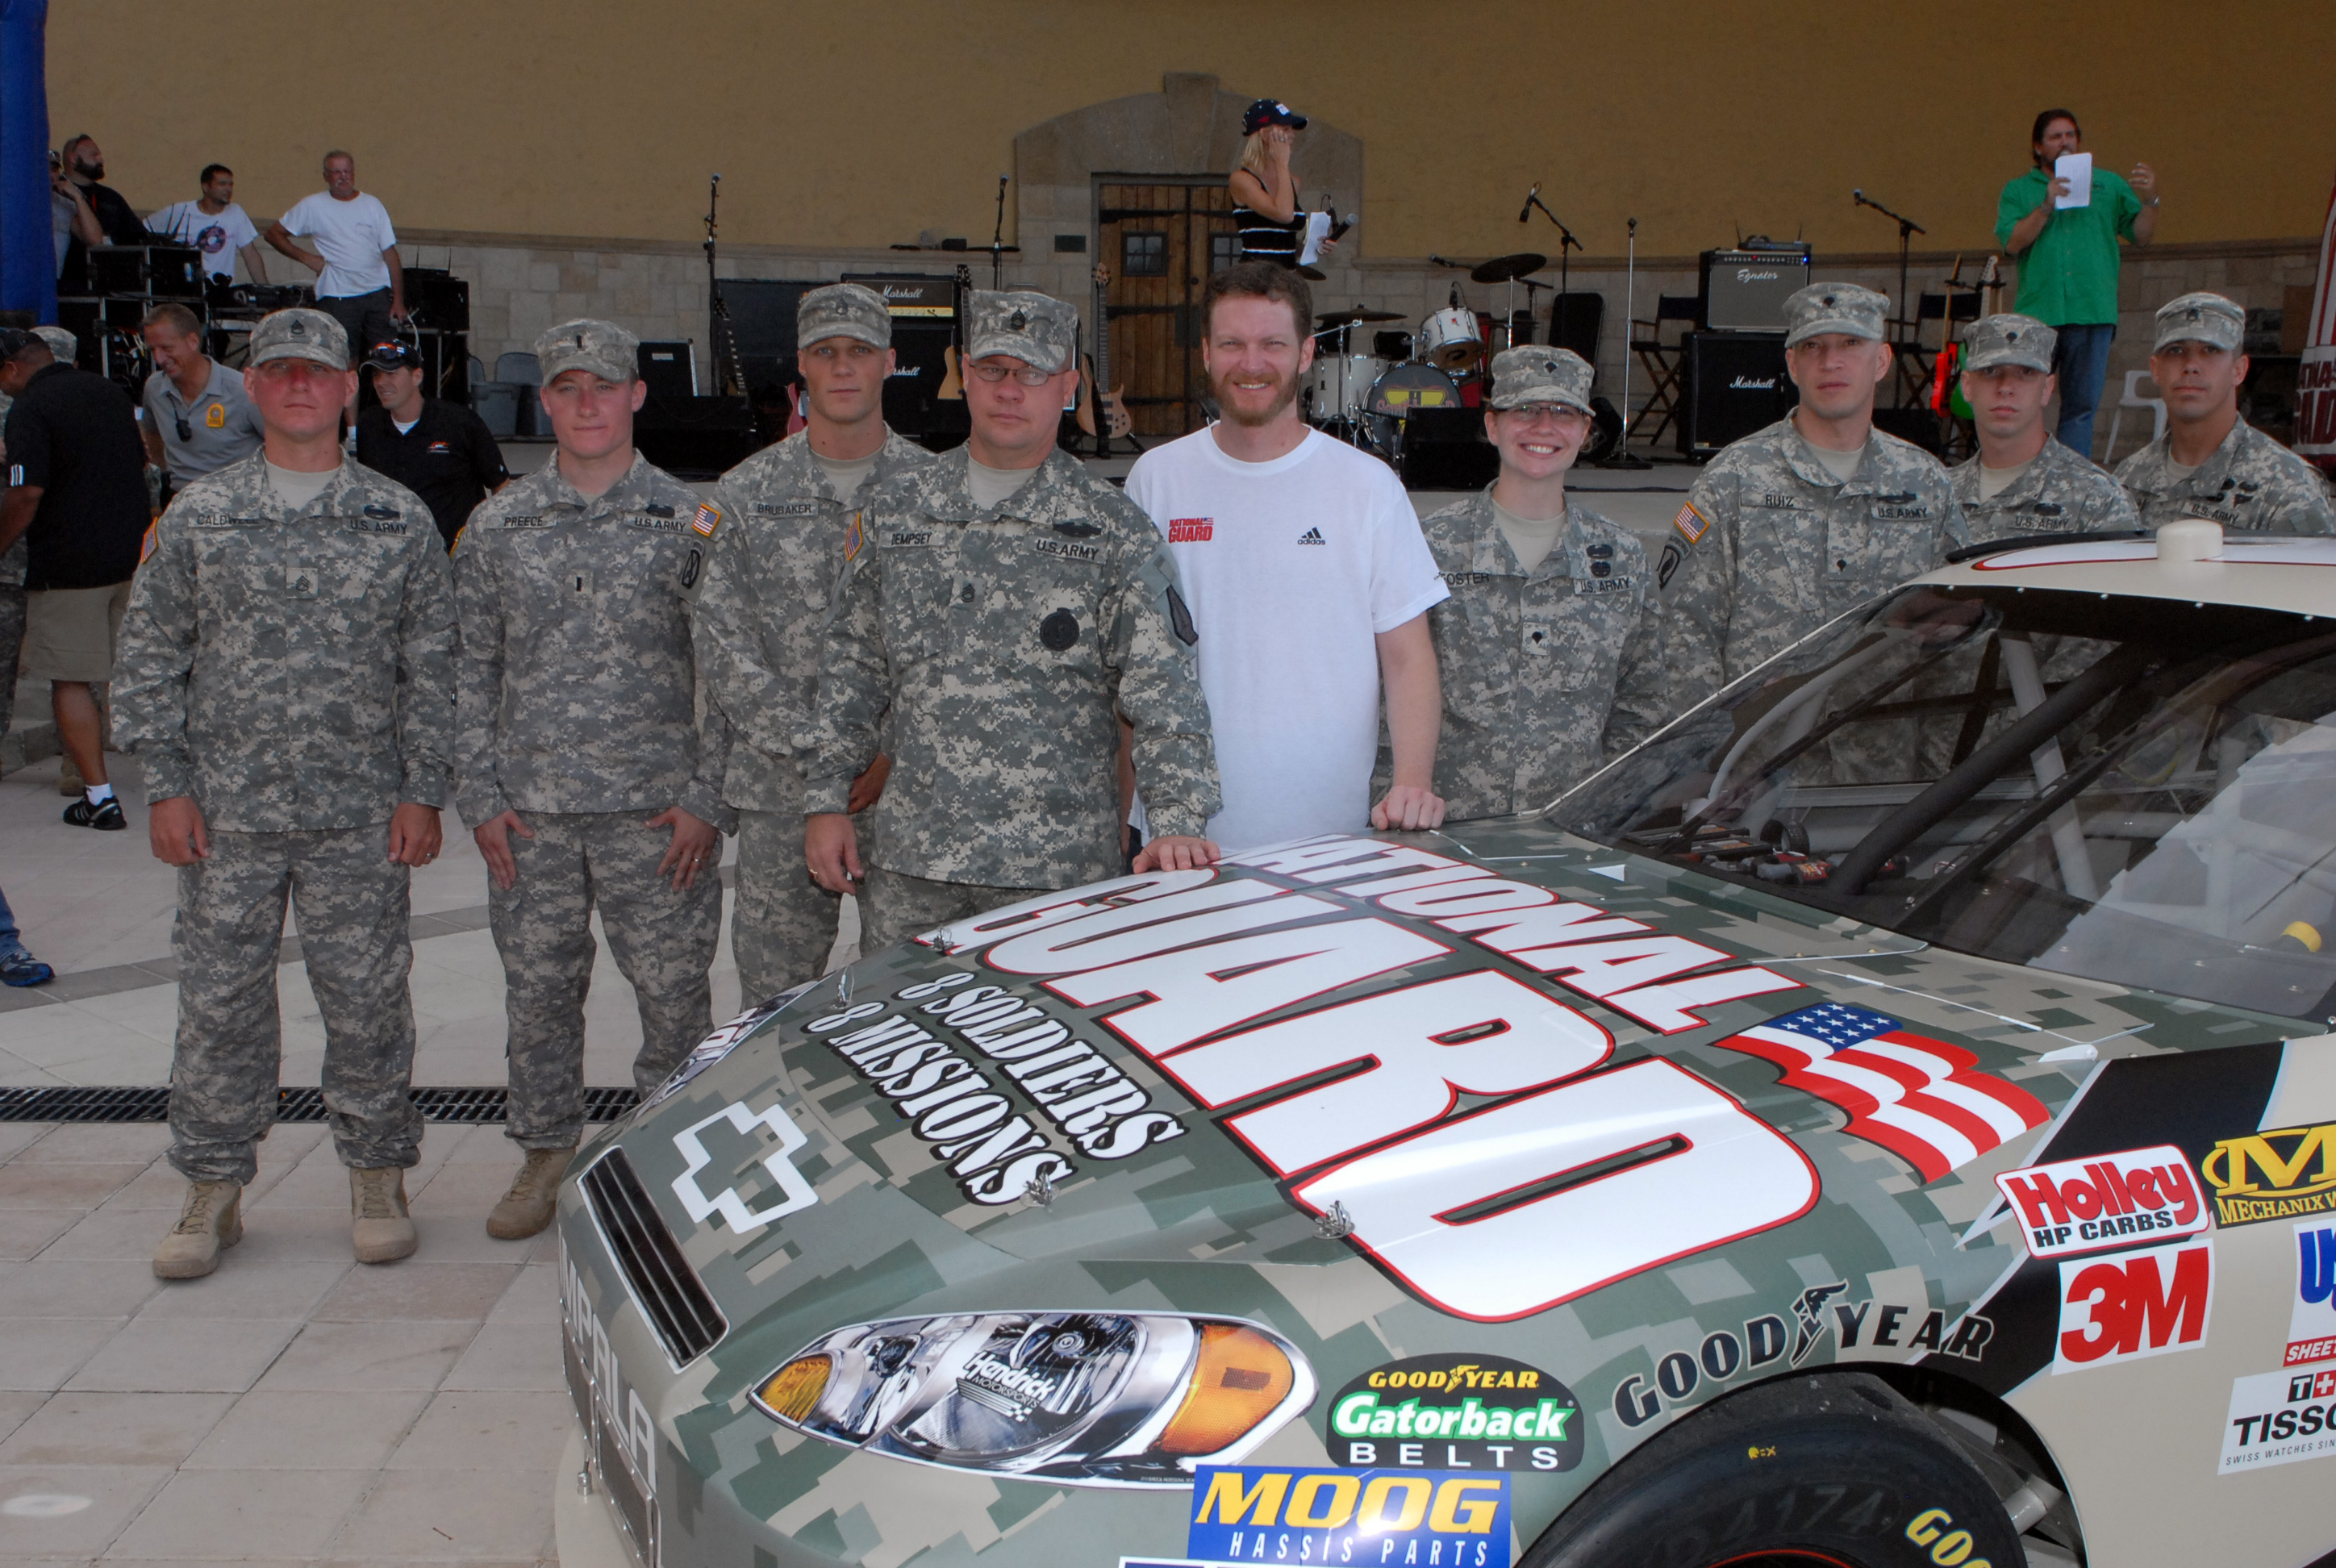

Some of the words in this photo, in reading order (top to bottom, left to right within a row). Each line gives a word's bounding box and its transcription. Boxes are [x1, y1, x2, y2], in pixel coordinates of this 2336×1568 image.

[882, 285, 923, 298] Marshall
[893, 366, 920, 377] rshall
[1729, 375, 1775, 389] Marshall
[757, 504, 811, 515] BRUBAKER
[1766, 494, 1794, 507] RUIZ
[1896, 507, 1927, 519] ARMY
[2192, 504, 2209, 516] U.S.
[2212, 510, 2238, 523] ARMY
[350, 520, 372, 532] U.S.
[375, 523, 407, 535] ARMY
[503, 516, 544, 527] PREECE
[654, 519, 686, 532] ARMY
[1169, 526, 1213, 543] GUARD
[1170, 519, 1203, 528] NATIONAL
[2038, 517, 2071, 529] ARMY
[891, 532, 932, 546] DEMPSEY
[1036, 539, 1059, 555] U.S.
[1059, 544, 1099, 561] ARMY
[1580, 581, 1597, 593] U.S.
[1600, 577, 1630, 591] ARMY
[1210, 833, 1808, 1034] NATIONAL
[891, 971, 978, 1000] 8
[801, 1000, 887, 1034] 8
[915, 985, 1191, 1160] SOLDIERS
[821, 1013, 1078, 1205] MISSIONS
[914, 868, 1821, 1324] GUARD
[2004, 1161, 2199, 1229] Holley
[2214, 1194, 2326, 1225] MECHANIX
[2033, 1227, 2072, 1248] HP
[2079, 1210, 2173, 1241] CARBS
[2299, 1228, 2336, 1312] U
[2060, 1246, 2209, 1363] 3M
[558, 1223, 656, 1495] IMPALA
[964, 1350, 1057, 1402] Hendrick
[972, 1375, 1041, 1408] MOTORSPORTS
[1333, 1394, 1573, 1440] Gatorback
[1349, 1442, 1558, 1470] BELTS
[2225, 1452, 2260, 1466] SWISS
[2265, 1442, 2313, 1460] WATCHES
[1195, 1471, 1502, 1534] MOOG
[1905, 1506, 1993, 1568] GO
[1380, 1537, 1488, 1566] PARTS
